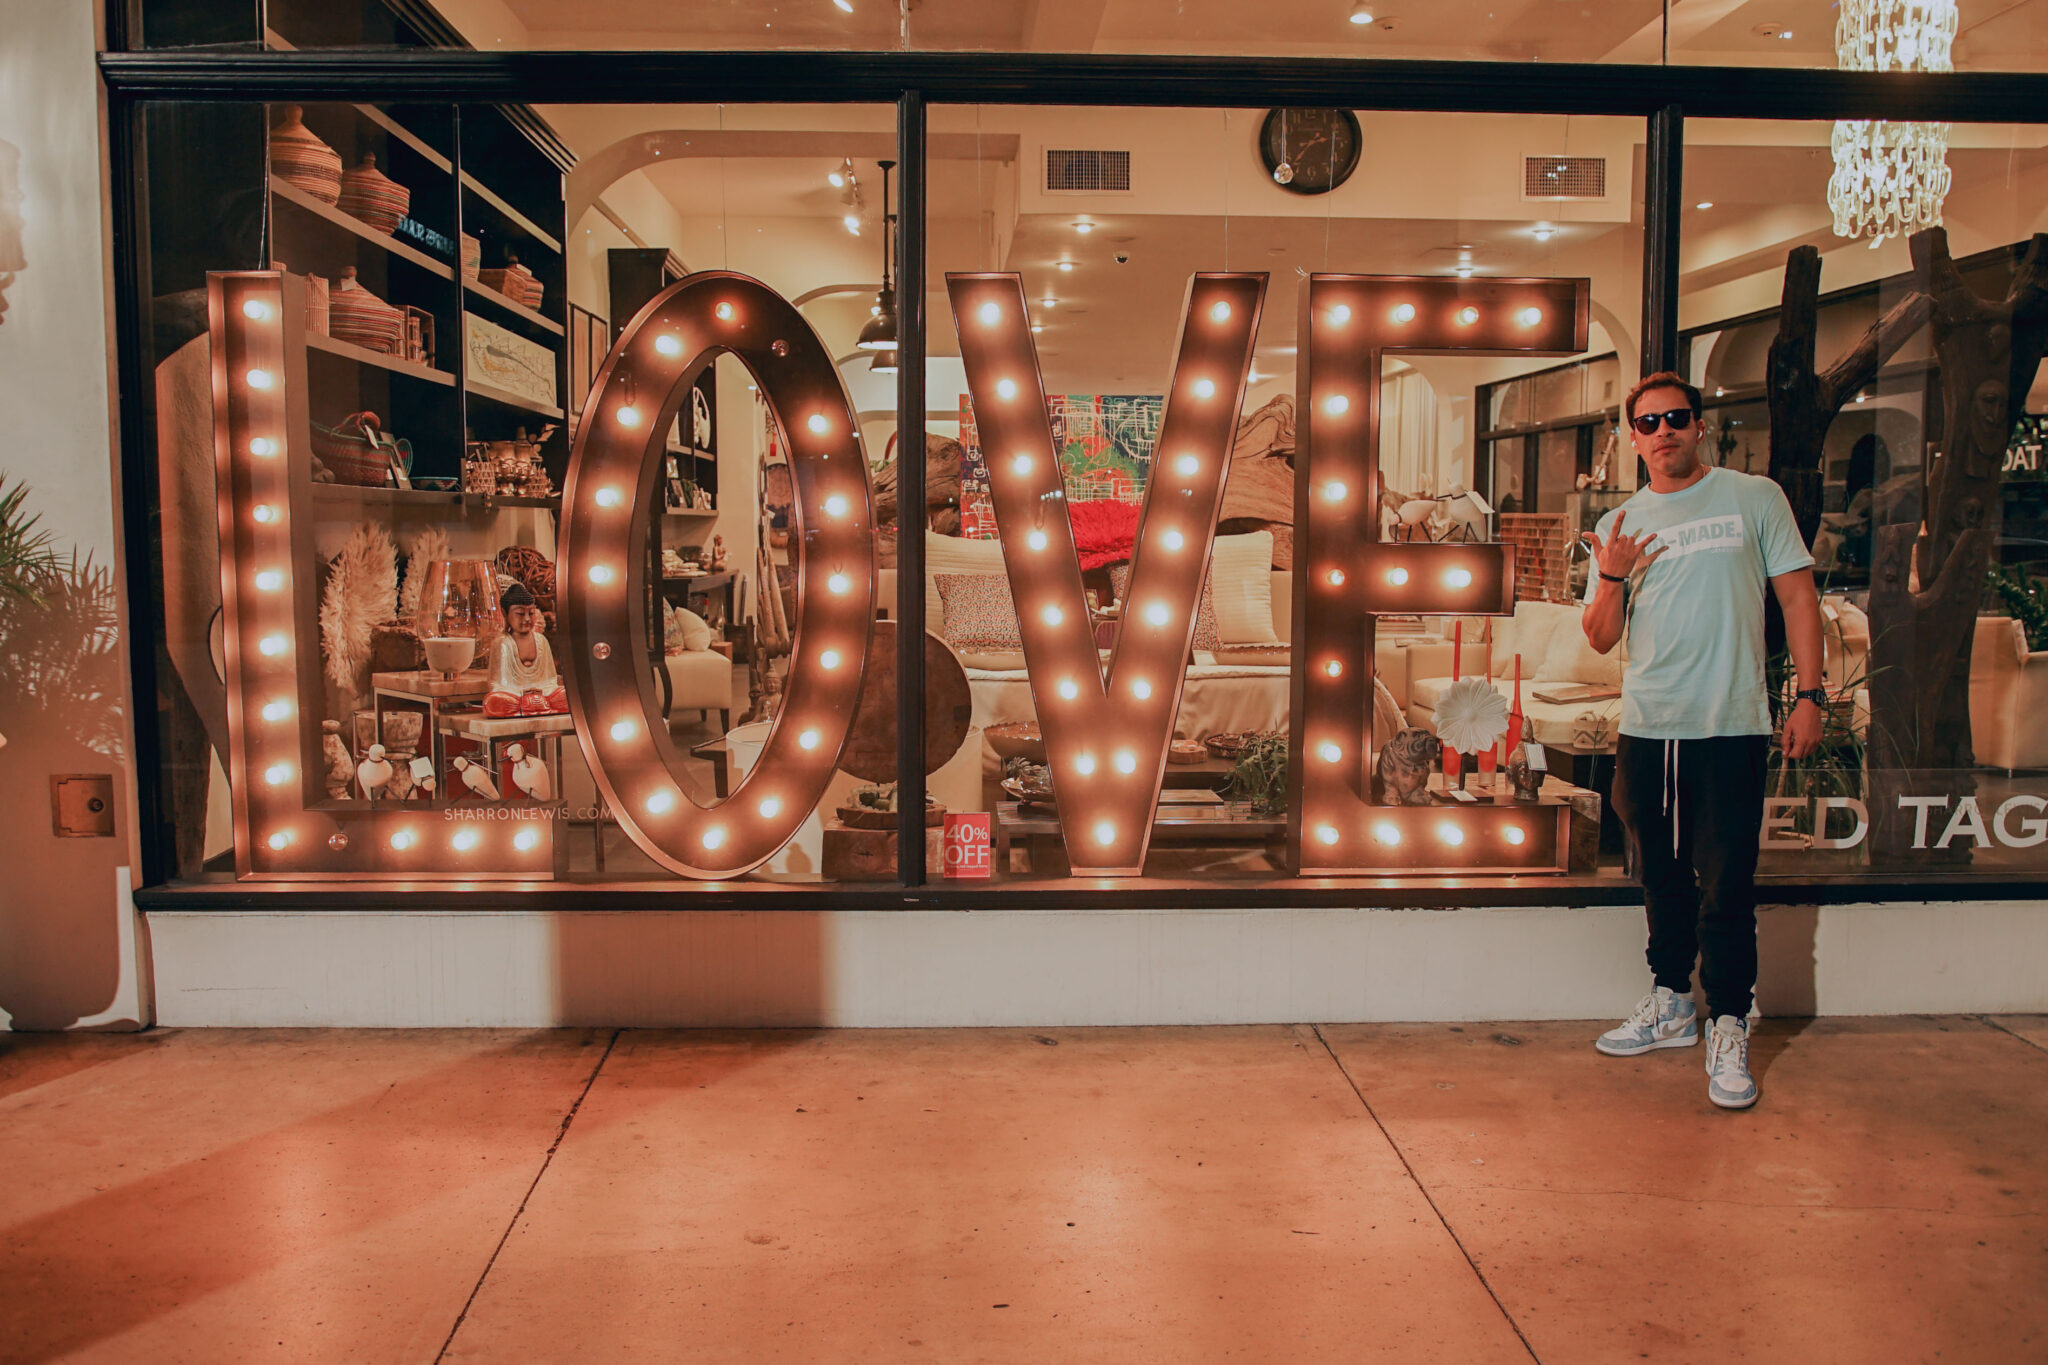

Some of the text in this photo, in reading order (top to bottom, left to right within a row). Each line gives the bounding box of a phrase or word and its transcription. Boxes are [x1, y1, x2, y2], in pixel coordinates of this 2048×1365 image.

[206, 270, 1590, 880] LOVE
[444, 807, 615, 821] SHARRONLEWIS.COM
[1898, 793, 2048, 849] TAG
[946, 823, 988, 843] 40%
[945, 844, 990, 865] OFF
